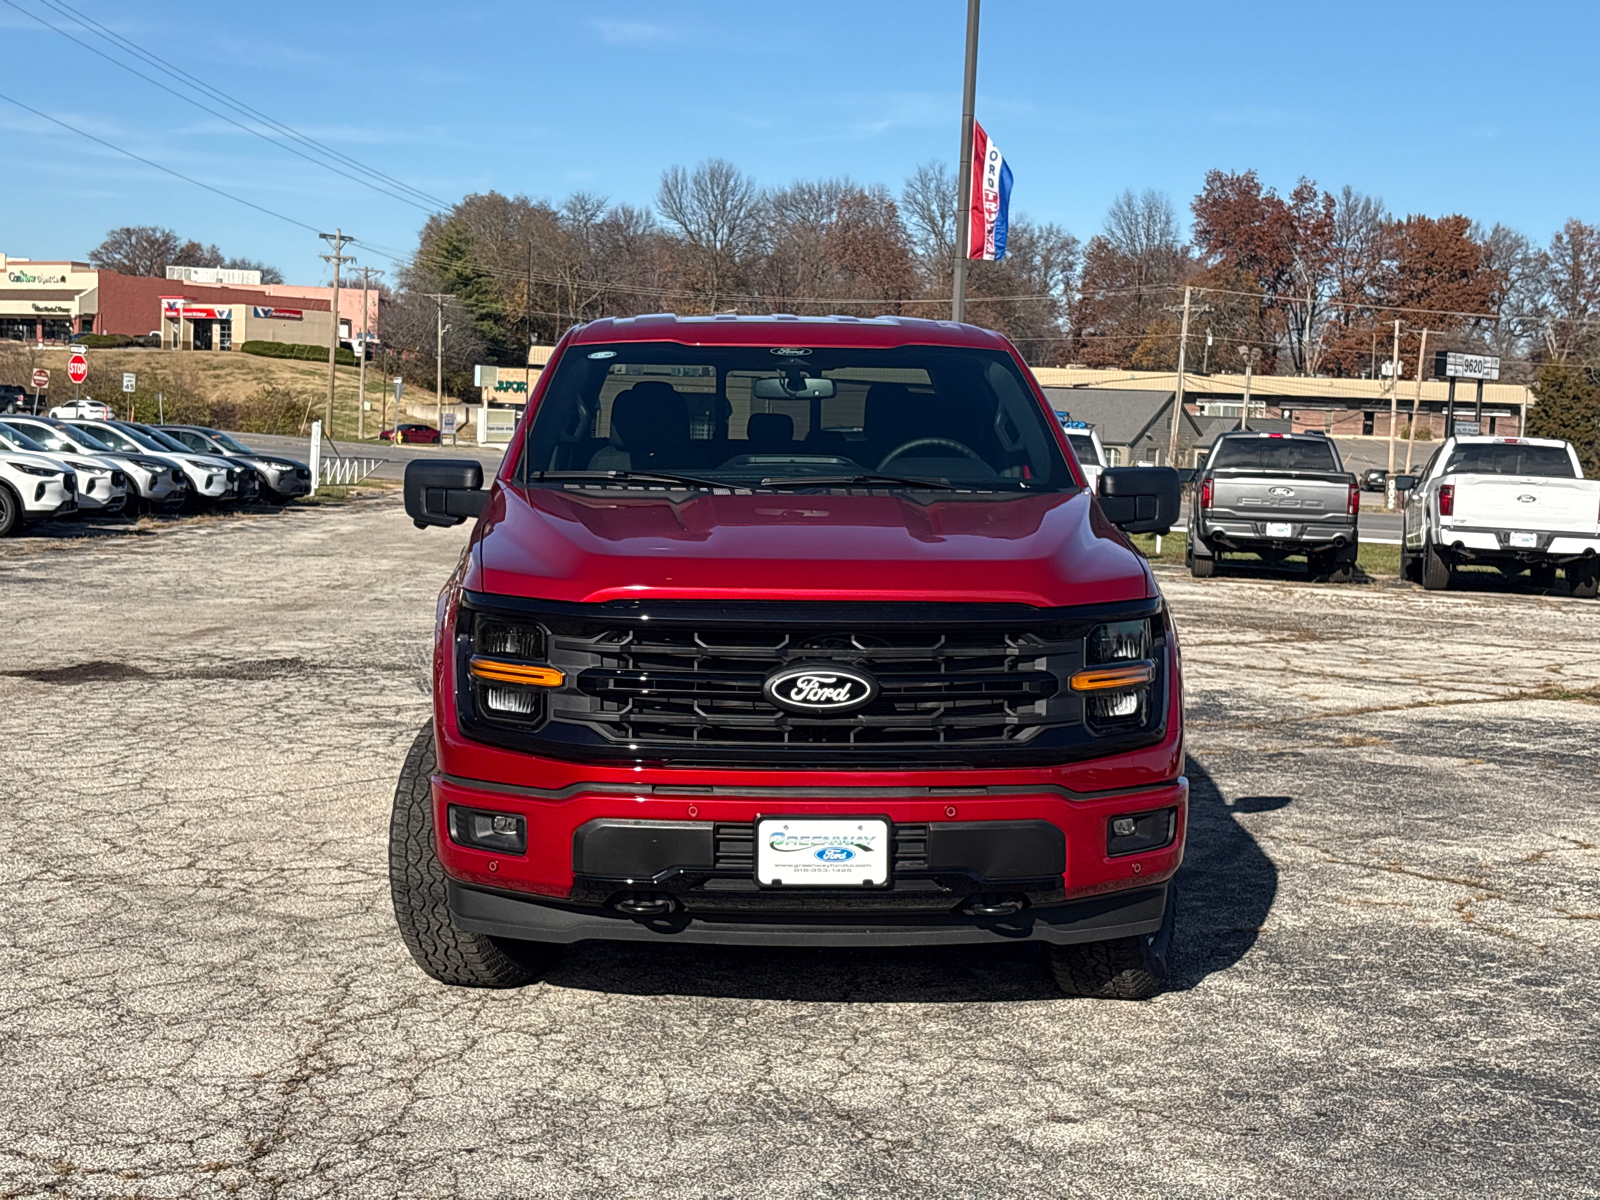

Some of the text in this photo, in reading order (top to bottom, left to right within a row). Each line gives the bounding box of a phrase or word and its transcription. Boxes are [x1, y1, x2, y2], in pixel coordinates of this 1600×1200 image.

[778, 348, 805, 356] Ford
[70, 363, 86, 374] STOP
[1464, 358, 1483, 374] 9620
[125, 383, 135, 391] 45
[790, 676, 852, 701] Ford
[769, 832, 876, 846] GREENWAY
[822, 849, 847, 861] Ford
